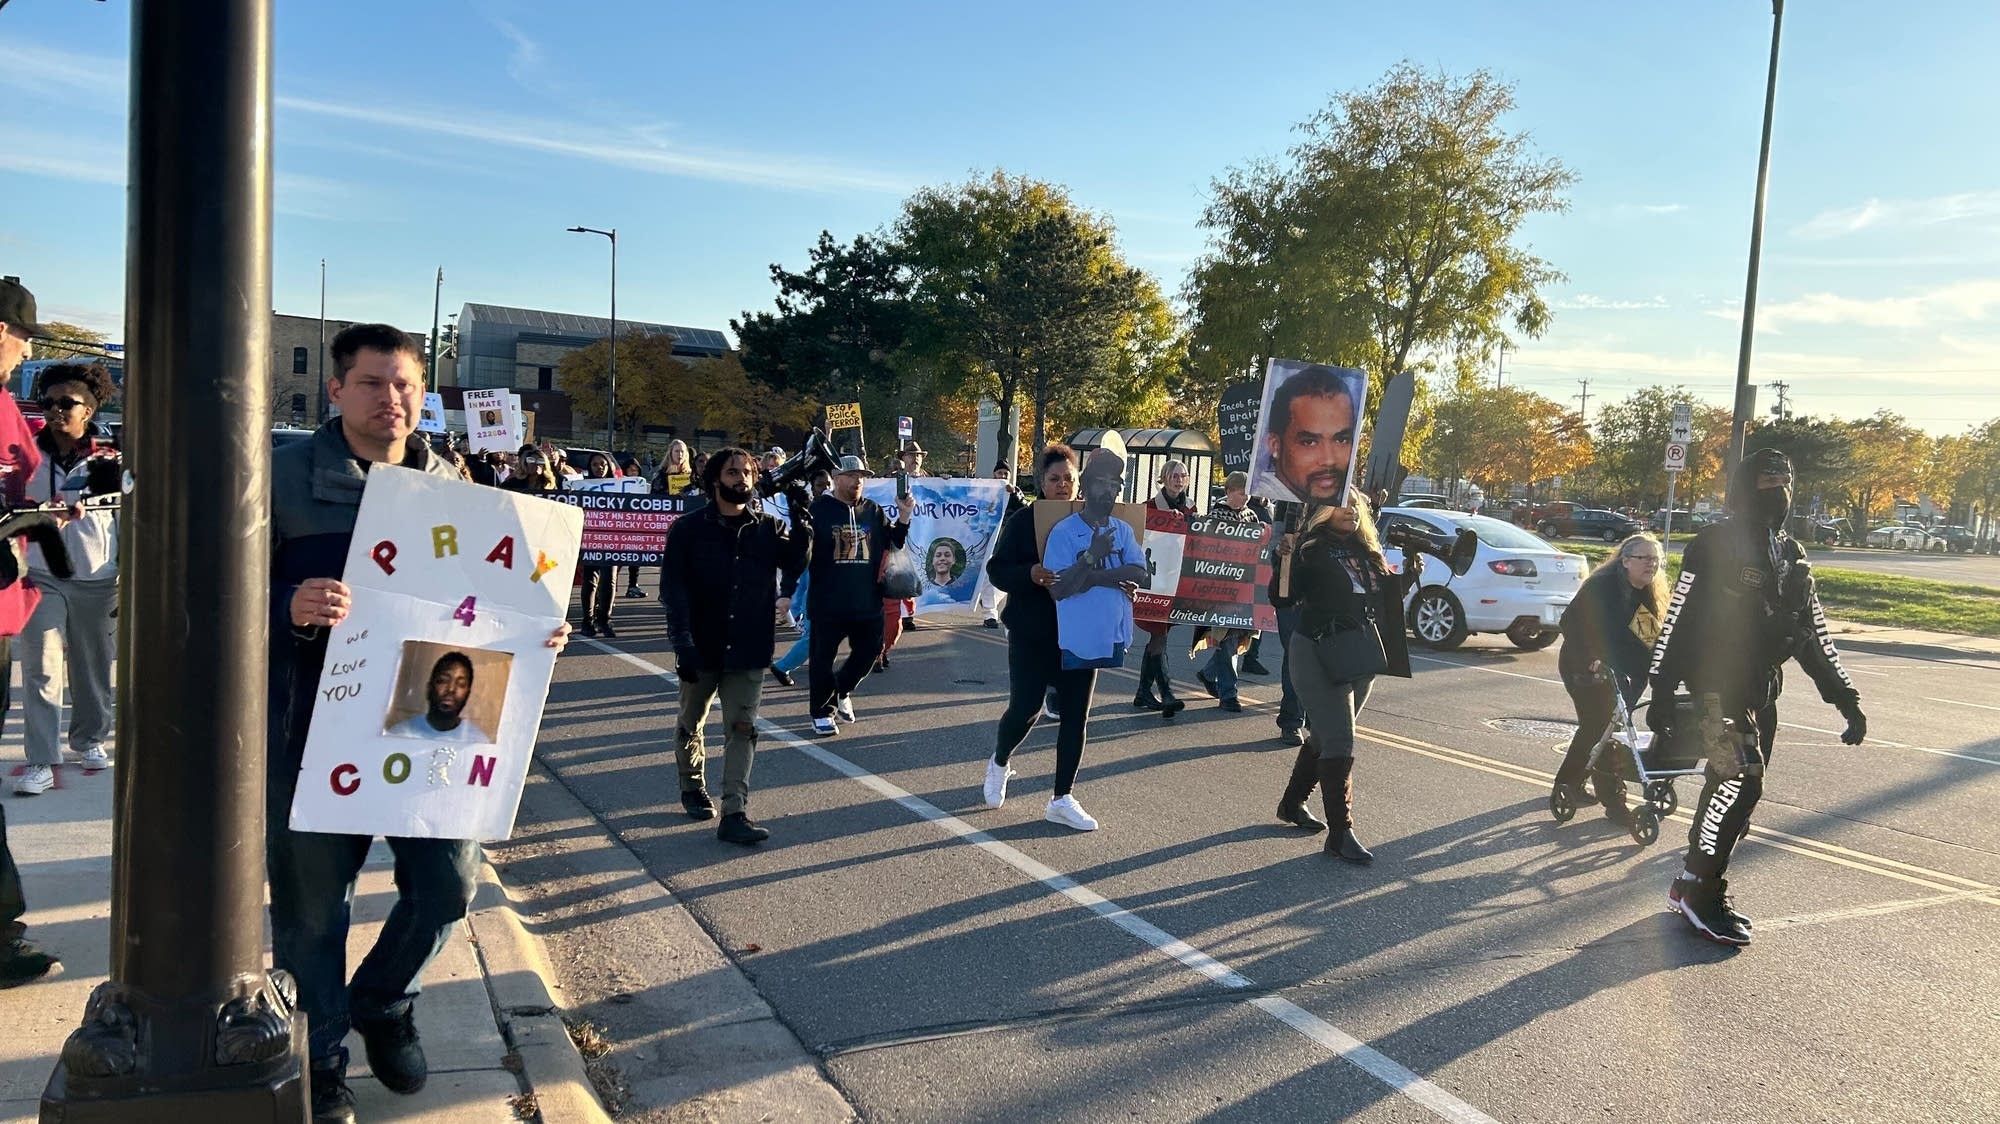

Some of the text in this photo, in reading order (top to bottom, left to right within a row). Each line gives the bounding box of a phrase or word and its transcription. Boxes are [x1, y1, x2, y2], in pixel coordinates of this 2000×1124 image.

[467, 390, 494, 400] FREE
[469, 400, 502, 409] INMATE
[830, 403, 853, 412] STOP
[1220, 400, 1245, 411] Jacob
[829, 411, 857, 419] Police
[830, 417, 860, 427] TERROR
[1220, 424, 1247, 436] Date
[1224, 448, 1250, 465] Unk
[582, 496, 626, 510] RICKY
[630, 498, 672, 512] COBB
[942, 502, 979, 519] KIDS
[626, 513, 653, 521] STATE
[616, 521, 641, 529] RICKY
[643, 522, 668, 530] COBB
[1190, 519, 1213, 533] of
[583, 552, 602, 561] AND
[605, 553, 640, 562] POSED
[642, 554, 658, 562] NO
[1194, 559, 1245, 581] Working
[453, 595, 478, 627] 4
[1169, 608, 1207, 623] United
[1209, 613, 1253, 627] Against
[1648, 570, 1696, 675] PROTECTION
[346, 629, 369, 644] we
[330, 656, 368, 677] Love
[321, 681, 363, 703] YOU
[1699, 779, 1743, 857] VETERANS
